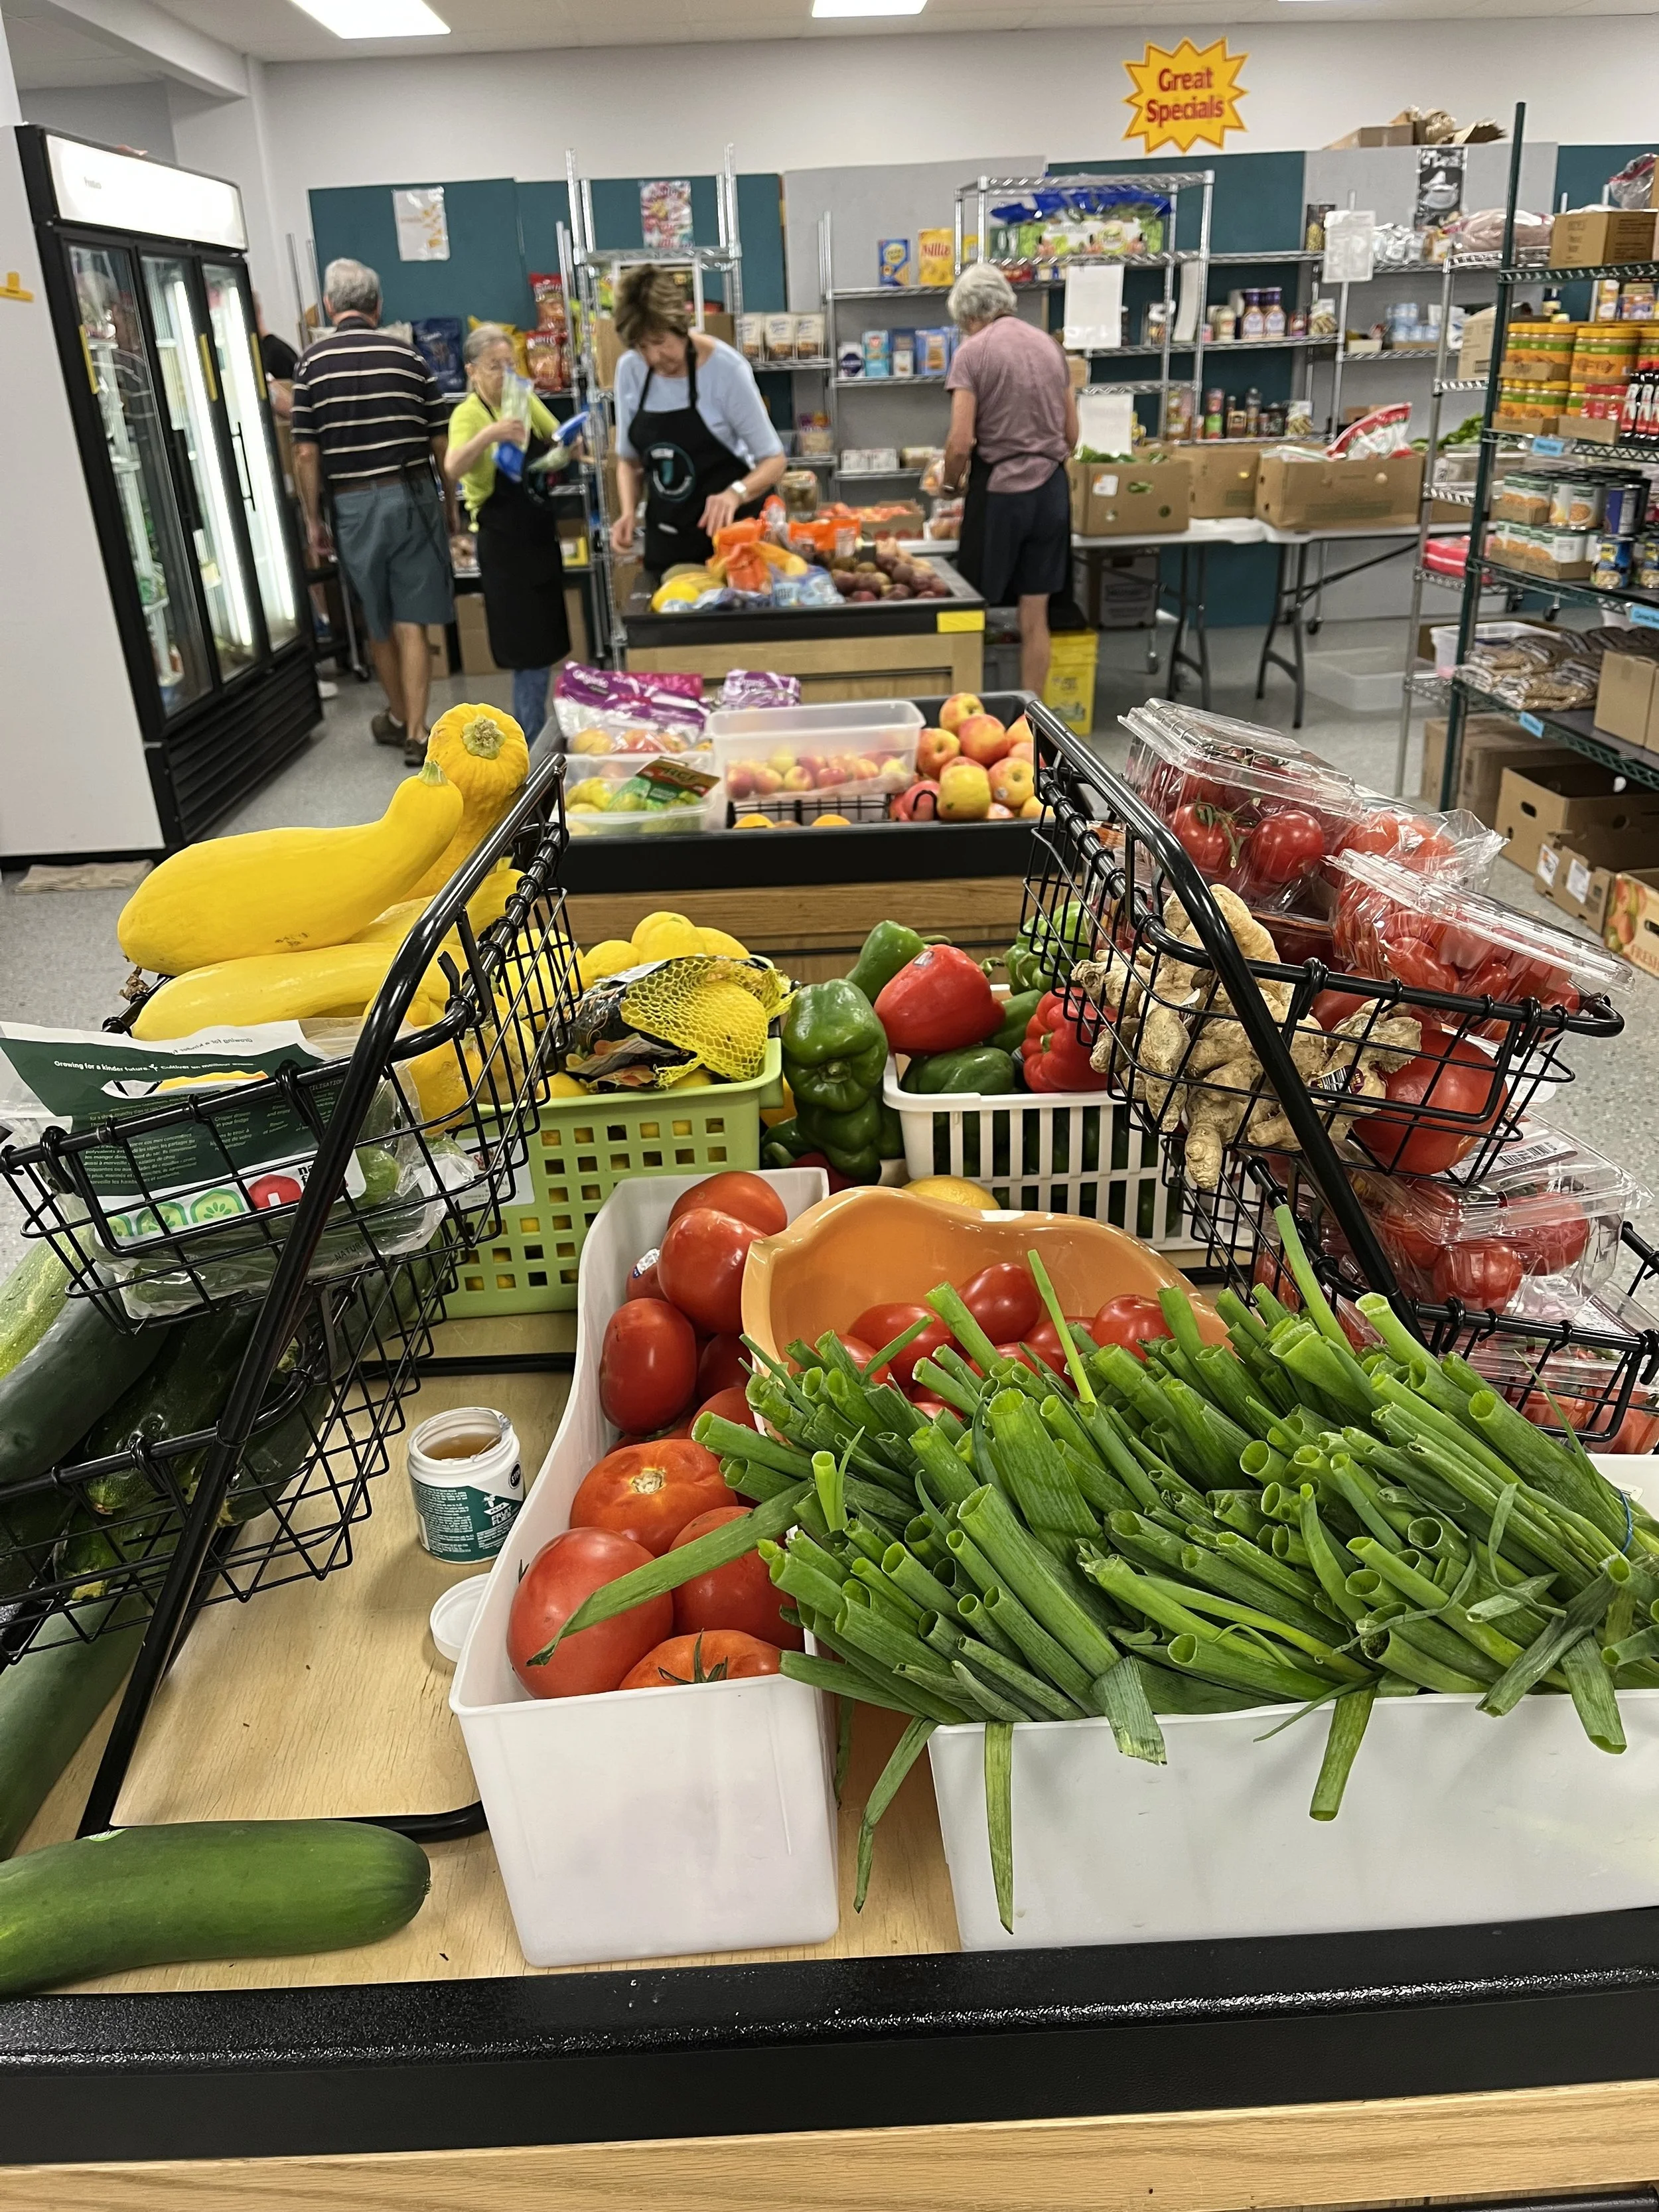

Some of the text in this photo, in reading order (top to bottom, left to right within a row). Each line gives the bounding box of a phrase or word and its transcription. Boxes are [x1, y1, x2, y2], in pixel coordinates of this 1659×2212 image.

[1159, 67, 1213, 92] Great
[1147, 96, 1224, 127] Specials
[54, 1060, 84, 1070] Growing
[102, 1063, 123, 1072] kinder
[334, 1240, 366, 1260] NATURE
